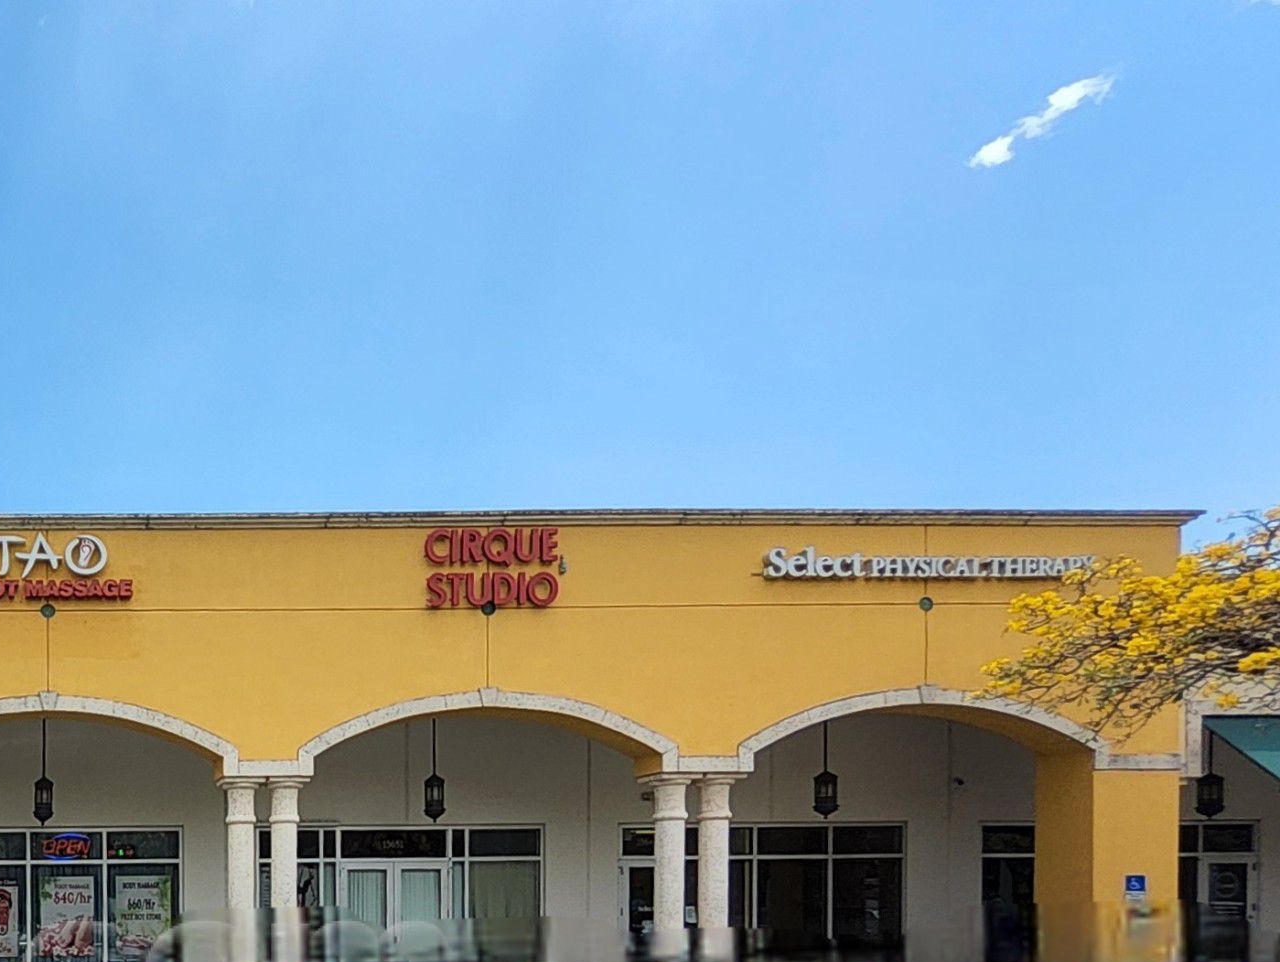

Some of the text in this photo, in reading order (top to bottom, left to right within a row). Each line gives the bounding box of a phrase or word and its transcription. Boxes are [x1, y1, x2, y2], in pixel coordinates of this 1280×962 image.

[424, 527, 558, 567] CIRQUE
[764, 545, 864, 580] Select
[868, 555, 988, 579] PHYSICAL
[24, 579, 133, 601] MASSAGE
[425, 571, 559, 608] STUDIO
[42, 839, 89, 855] OPEN
